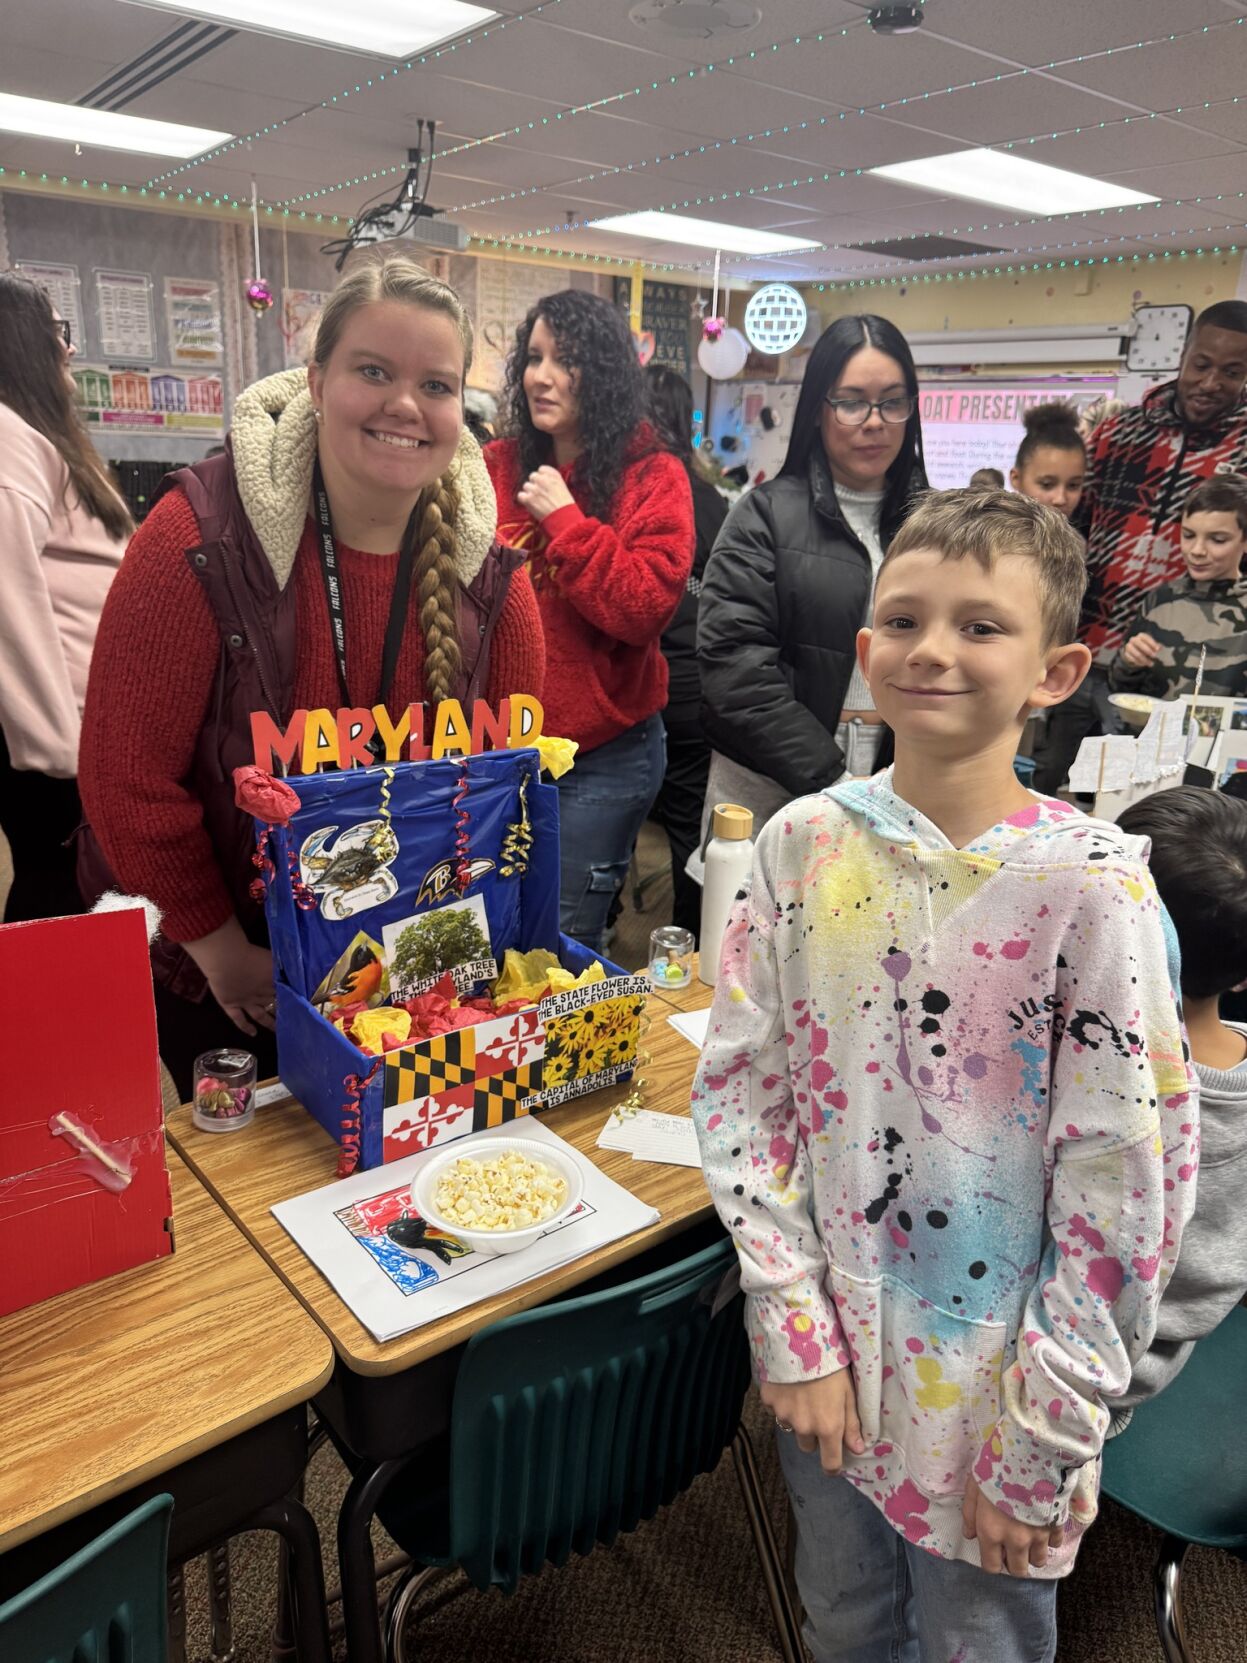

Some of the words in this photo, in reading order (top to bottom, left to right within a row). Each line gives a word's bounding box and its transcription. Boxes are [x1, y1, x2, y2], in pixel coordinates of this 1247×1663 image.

[619, 281, 688, 301] AWAYS
[923, 395, 953, 420] OAT
[323, 534, 336, 568] FALCONS
[328, 575, 341, 610] FALCONS
[334, 618, 345, 652] FALCONS
[250, 693, 544, 775] MARYLAND
[391, 986, 409, 1000] THE
[470, 960, 495, 972] TREE
[541, 995, 558, 1008] THE
[561, 986, 589, 1002] STATE
[591, 977, 629, 994] FLOWER
[632, 976, 646, 986] IS
[555, 989, 614, 1014] BLACK-EYED
[617, 985, 653, 996] SUSAN.
[521, 1096, 537, 1108] THE
[540, 1081, 580, 1099] CAPITAL
[582, 1075, 593, 1086] OF
[550, 1095, 560, 1106] IS
[563, 1076, 616, 1100] ANNAPOLIS.
